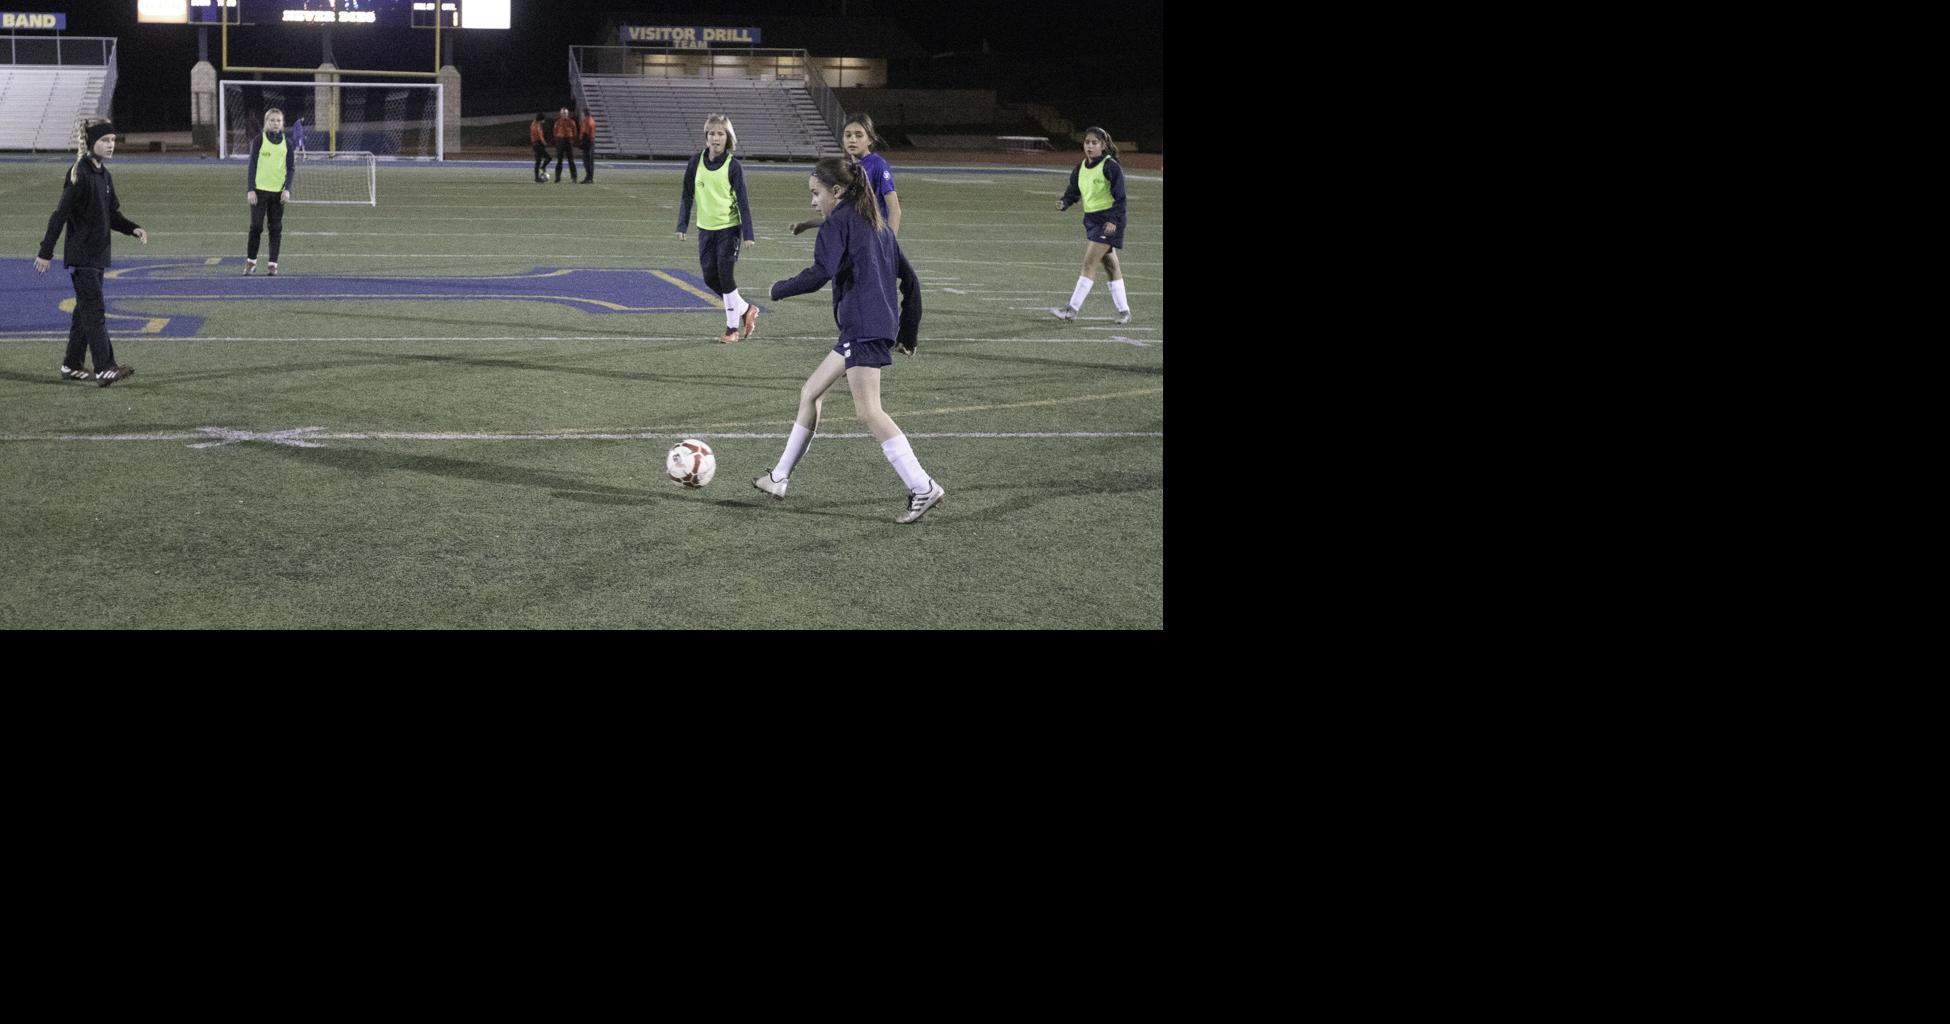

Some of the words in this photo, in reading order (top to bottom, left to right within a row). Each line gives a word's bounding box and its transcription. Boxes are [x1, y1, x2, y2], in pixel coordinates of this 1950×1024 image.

[2, 13, 56, 29] BAND
[628, 26, 696, 41] VISITOR
[702, 28, 752, 42] DRILL
[672, 40, 709, 49] TEAM
